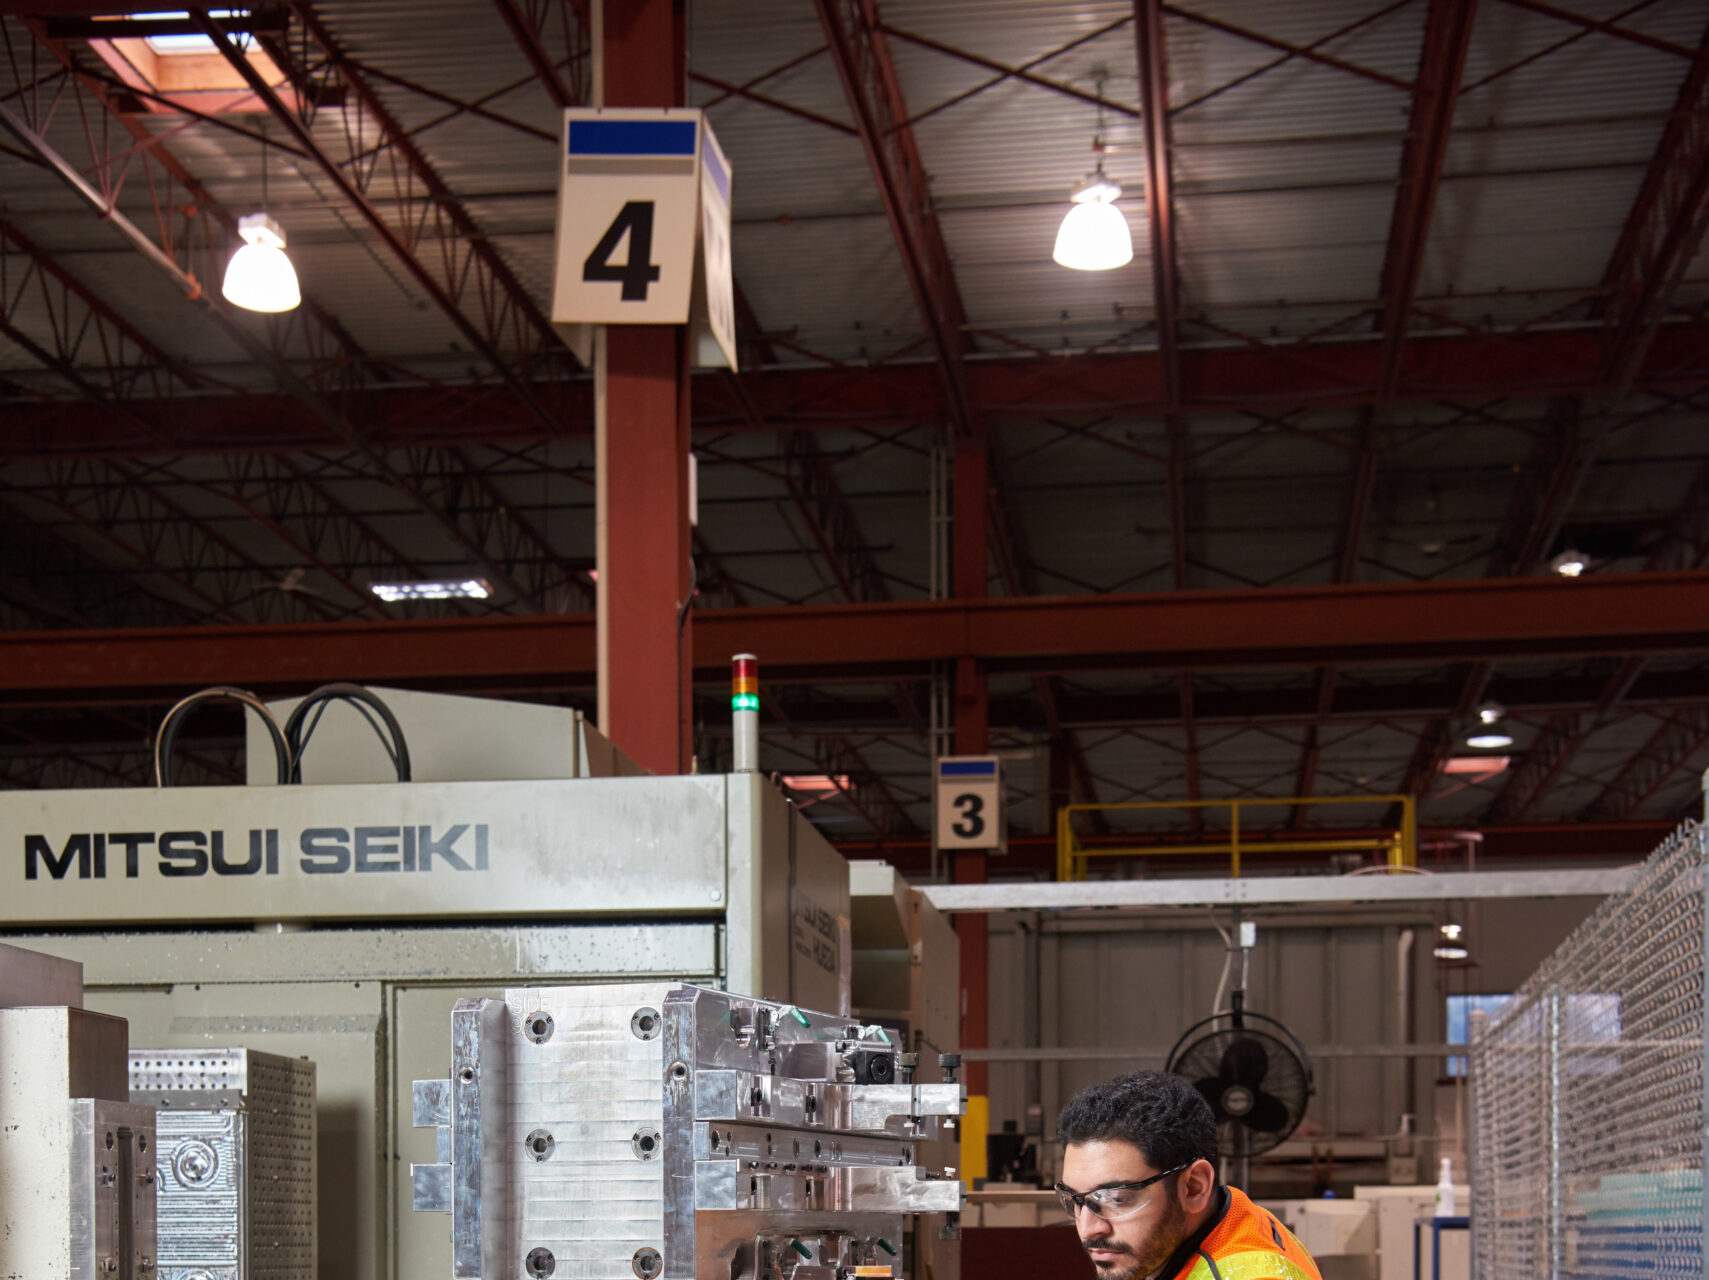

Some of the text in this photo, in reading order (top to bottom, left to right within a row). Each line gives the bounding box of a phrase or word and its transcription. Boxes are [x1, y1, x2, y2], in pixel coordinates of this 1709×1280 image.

[583, 200, 661, 302] 4
[952, 792, 985, 840] 3
[24, 824, 489, 880] MITSUI SEIKI
